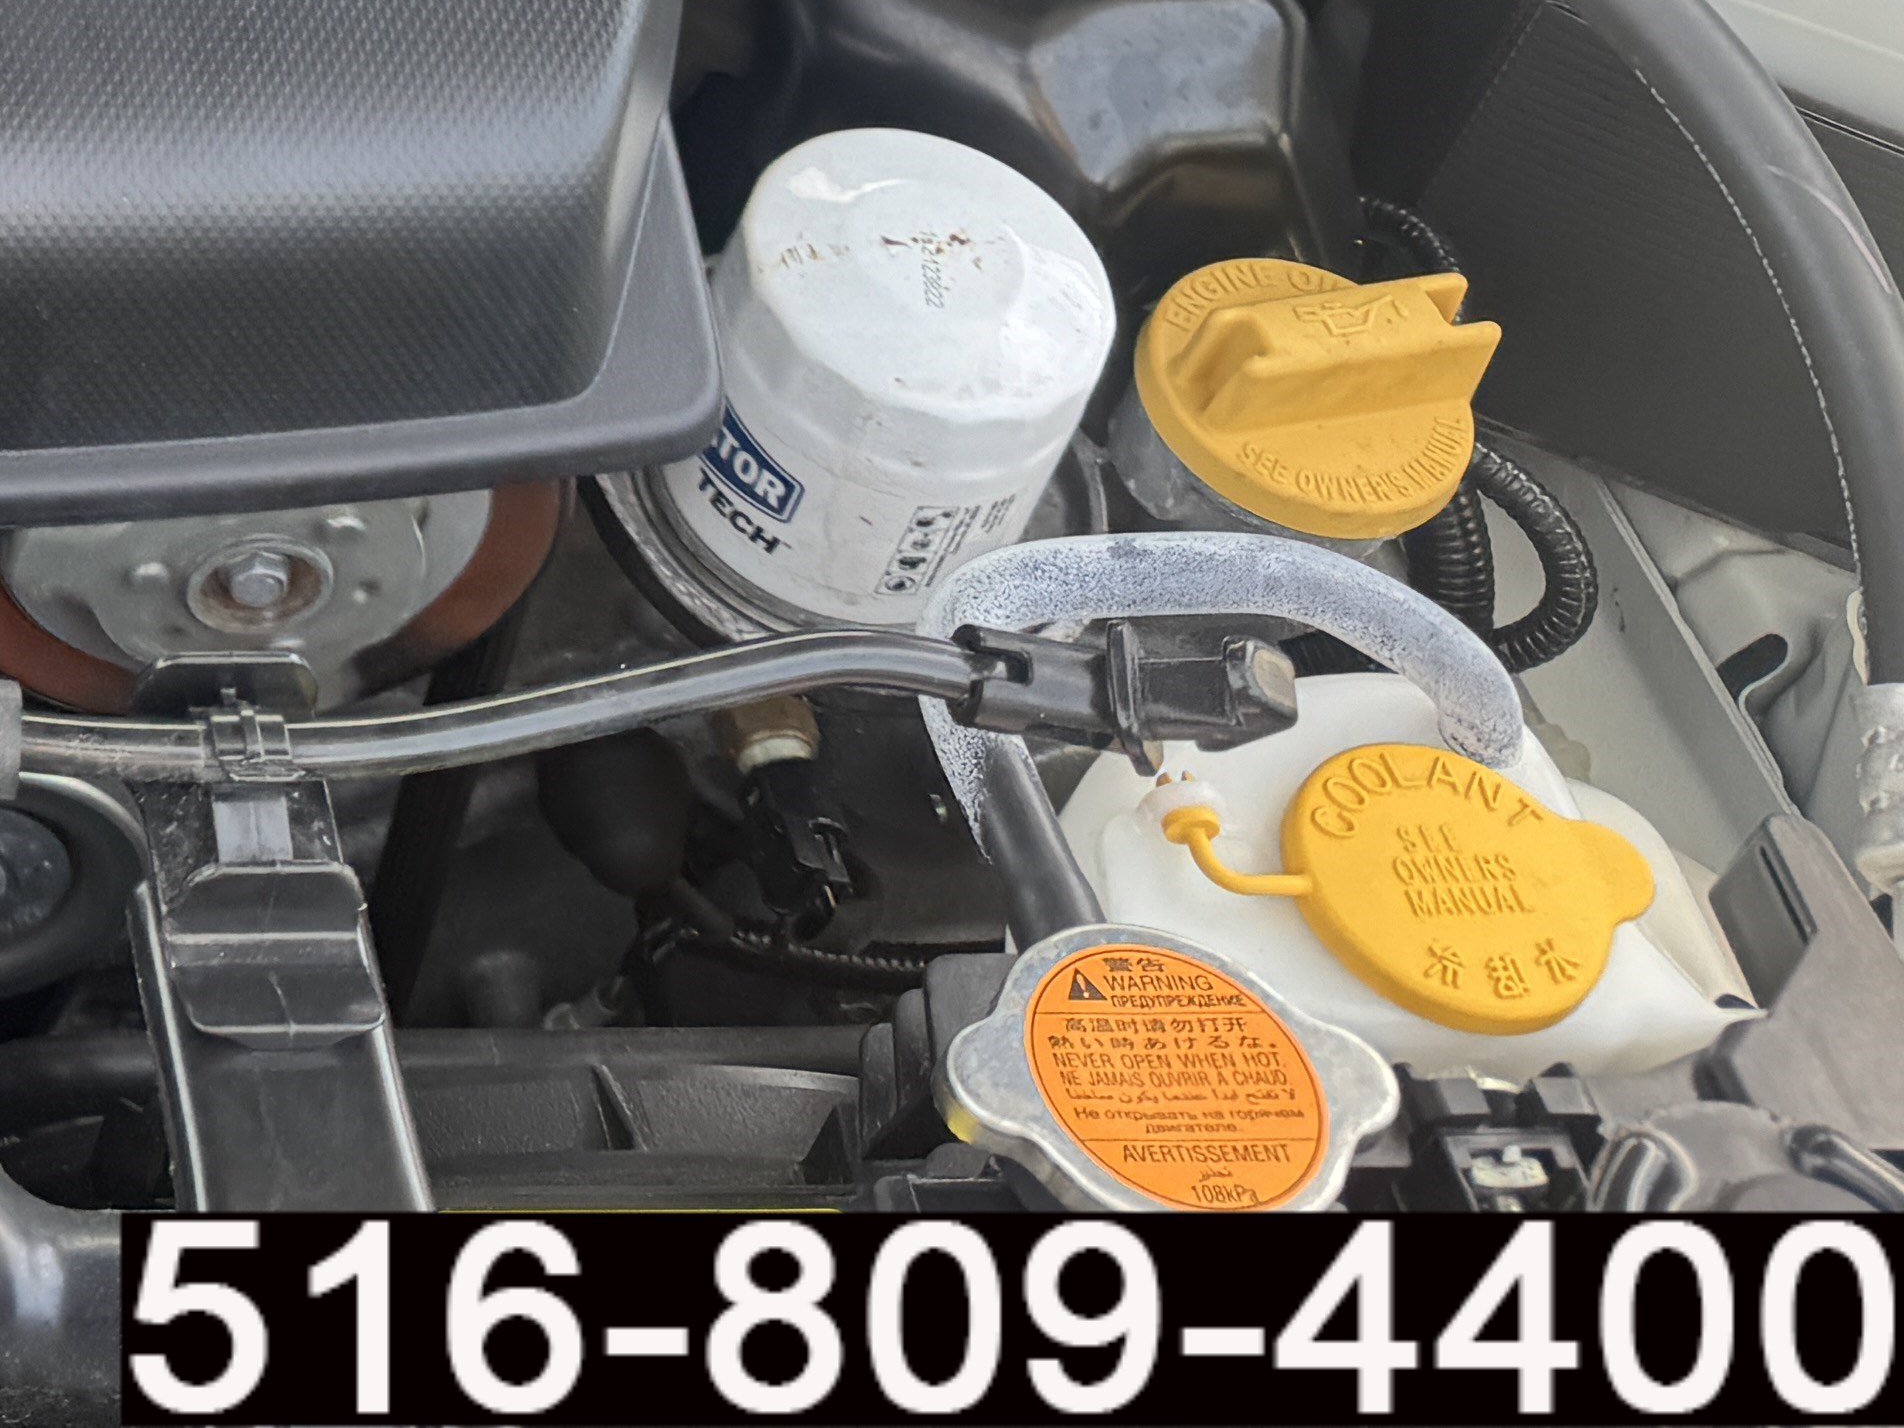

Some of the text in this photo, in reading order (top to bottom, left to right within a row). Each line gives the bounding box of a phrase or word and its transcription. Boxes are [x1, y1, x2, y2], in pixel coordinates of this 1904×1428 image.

[1164, 262, 1278, 332] ENGINE
[703, 431, 788, 503] TOR
[1241, 416, 1463, 504] SEE OWNER'S MANUAL
[698, 466, 782, 554] TECH
[1310, 752, 1545, 840] COOLANT
[1395, 824, 1460, 854] SEE
[1392, 853, 1518, 885] OWNERS
[1403, 884, 1536, 920] MANUAL
[1103, 975, 1214, 992] WARNING
[1052, 1052, 1114, 1070] NEVER
[1121, 1052, 1171, 1070] OPEN
[1176, 1052, 1236, 1069] WHEN
[1060, 1070, 1081, 1087] NE
[1088, 1070, 1145, 1087] JAMAIS
[1149, 1070, 1210, 1088] OUVRIR
[1123, 1144, 1291, 1164] AVERTISSEMENT
[1191, 1184, 1259, 1204] 108kPa
